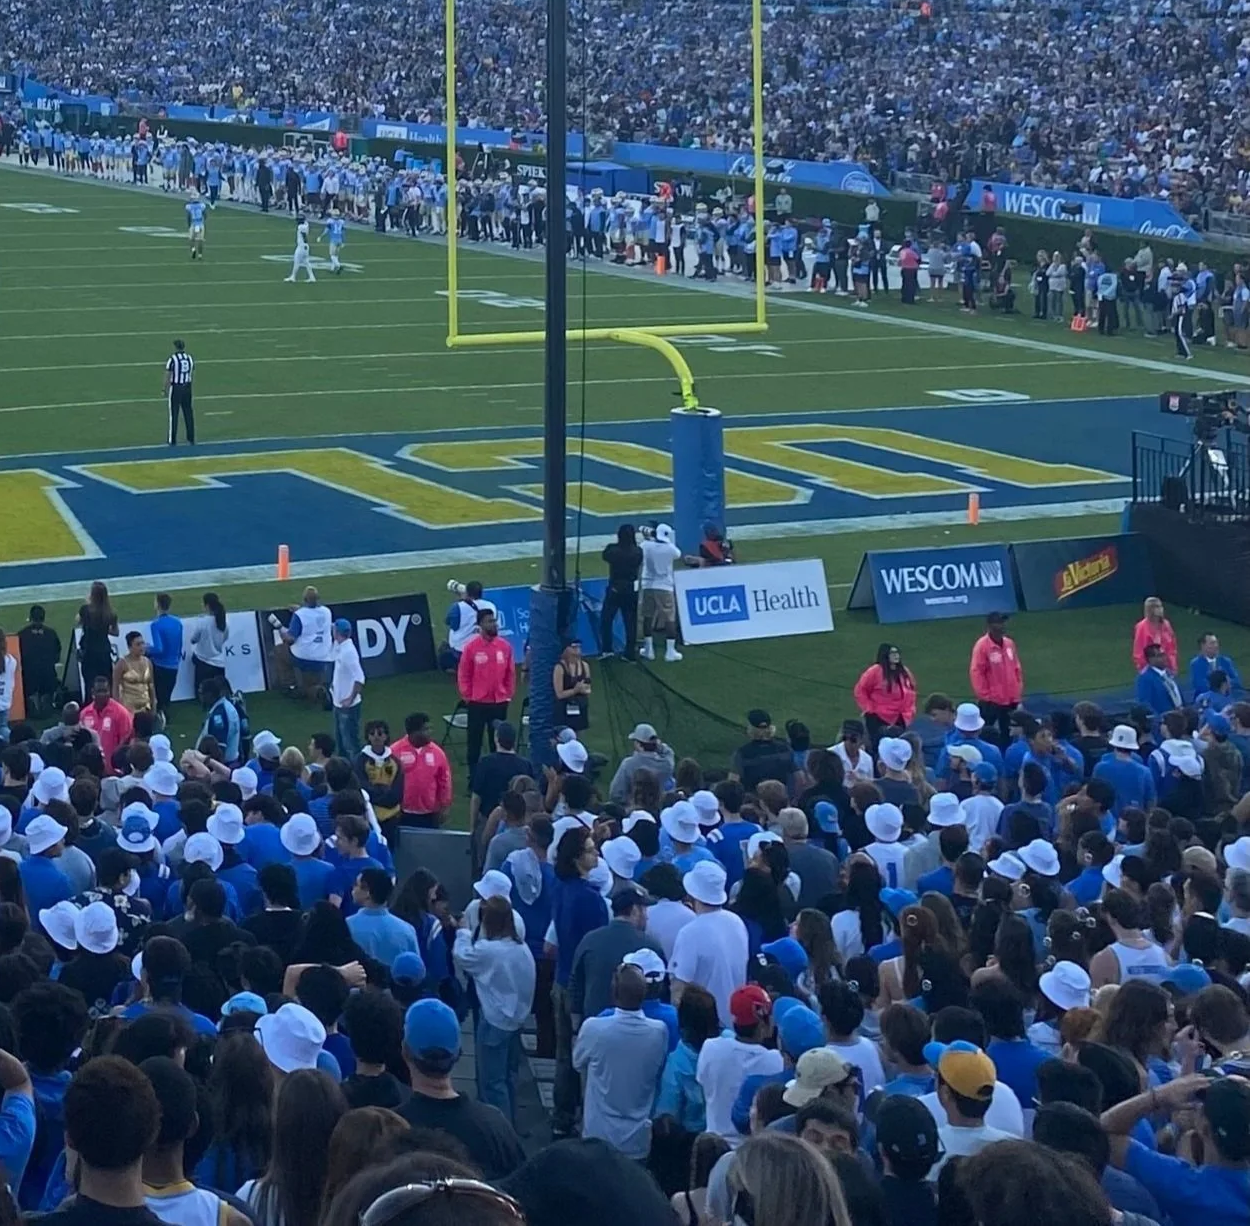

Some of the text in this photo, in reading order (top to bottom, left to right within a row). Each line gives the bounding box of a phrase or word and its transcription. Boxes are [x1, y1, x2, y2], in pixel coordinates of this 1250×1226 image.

[880, 562, 980, 595] WESCOM
[694, 585, 820, 617] UCLA Health
